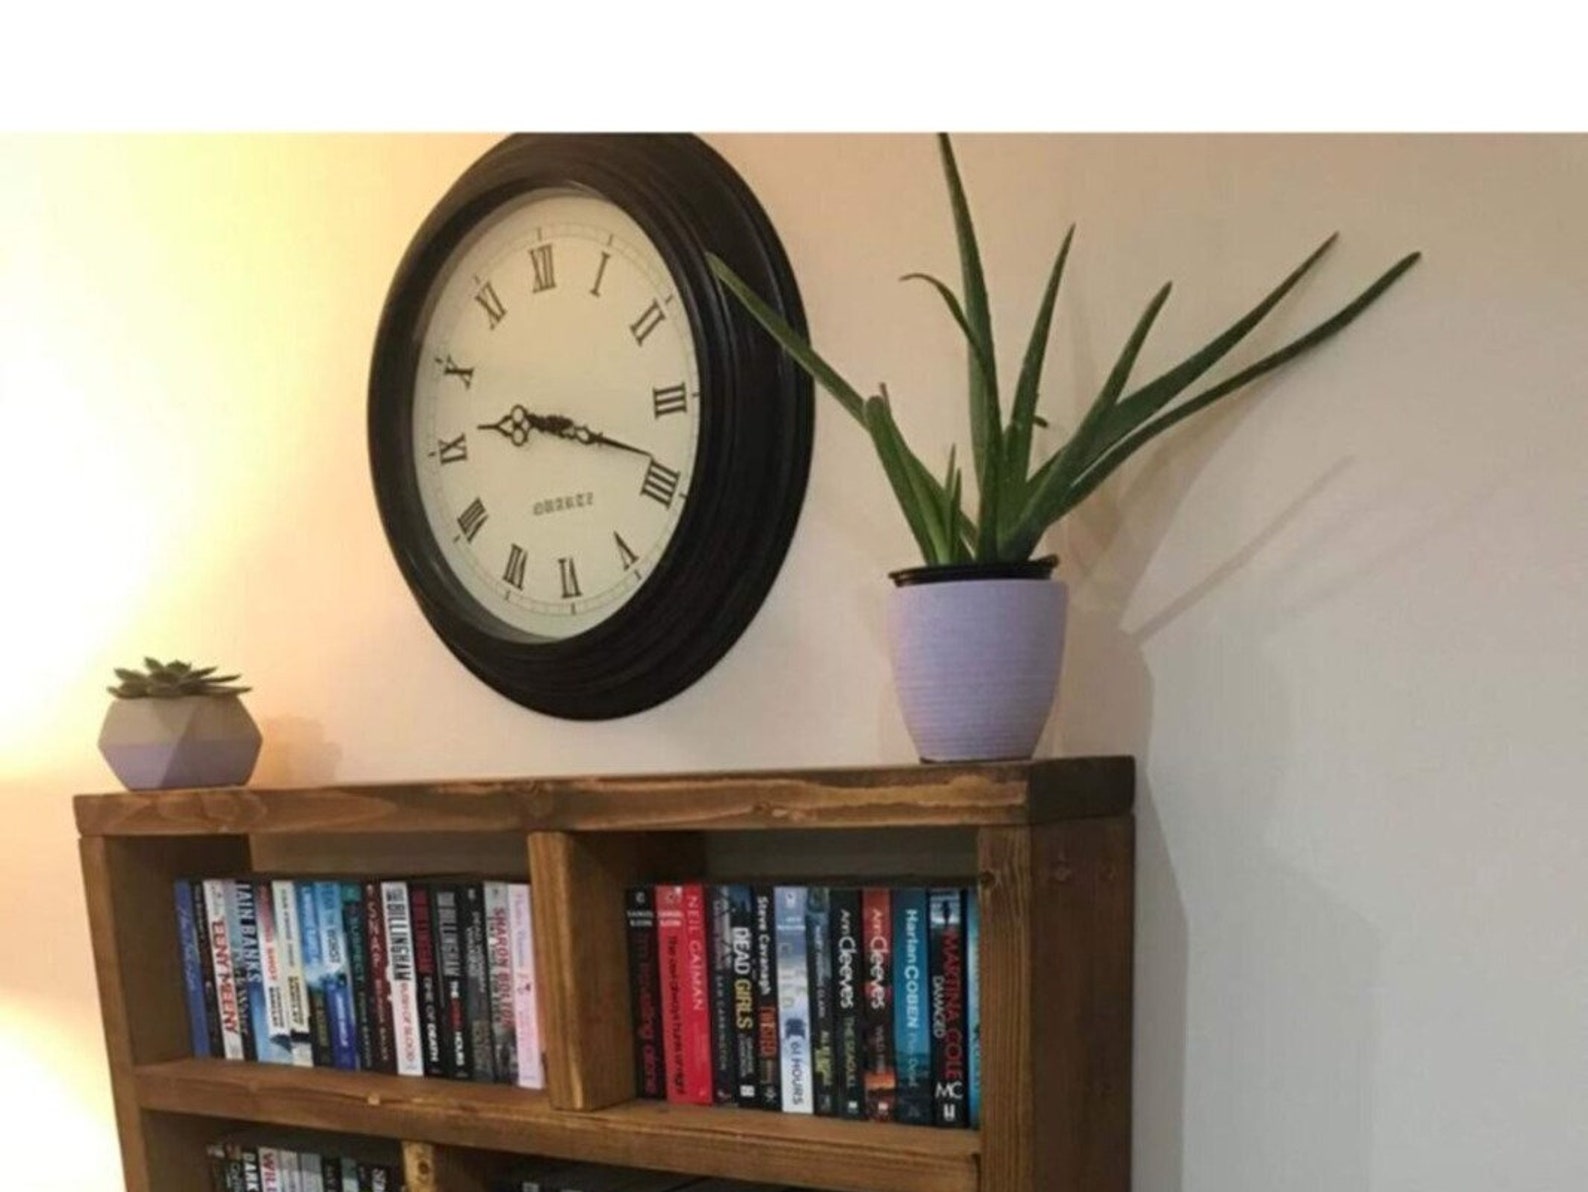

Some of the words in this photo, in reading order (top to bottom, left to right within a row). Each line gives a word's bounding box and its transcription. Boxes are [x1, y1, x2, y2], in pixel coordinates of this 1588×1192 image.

[528, 244, 557, 293] XII
[590, 251, 610, 296] I
[475, 280, 508, 330] XI
[630, 297, 666, 346] II
[444, 355, 475, 387] X
[652, 382, 688, 418] III
[440, 434, 467, 464] IX
[504, 543, 528, 590] VII
[613, 531, 639, 571] V
[559, 557, 582, 598] VI
[235, 884, 252, 919] IAIN
[687, 895, 700, 933] NEIL
[757, 896, 769, 931] Steve
[213, 921, 229, 969] EENY
[240, 925, 261, 983] BANKS
[387, 903, 412, 981] BILLINGHAM
[494, 907, 510, 968] SHARON
[732, 927, 751, 974] DEAD
[905, 909, 919, 963] Harlan
[690, 940, 704, 1011] GAIMAN
[758, 934, 771, 995] Cavanagh
[838, 936, 857, 1009] Cleeves
[869, 936, 888, 1009] Cleeves
[943, 930, 959, 1021] MARTINA
[217, 973, 238, 1034] MEENY
[498, 972, 514, 1030] BOLTON
[734, 979, 753, 1029] GIRLS
[904, 965, 919, 1029] COBEN
[932, 975, 944, 1039] DAMAGED
[427, 1023, 439, 1062] DEATH
[454, 1031, 465, 1066] HOURS
[944, 1028, 963, 1080] COLE
[792, 1058, 804, 1105] HOURS
[934, 1082, 964, 1099] MC
